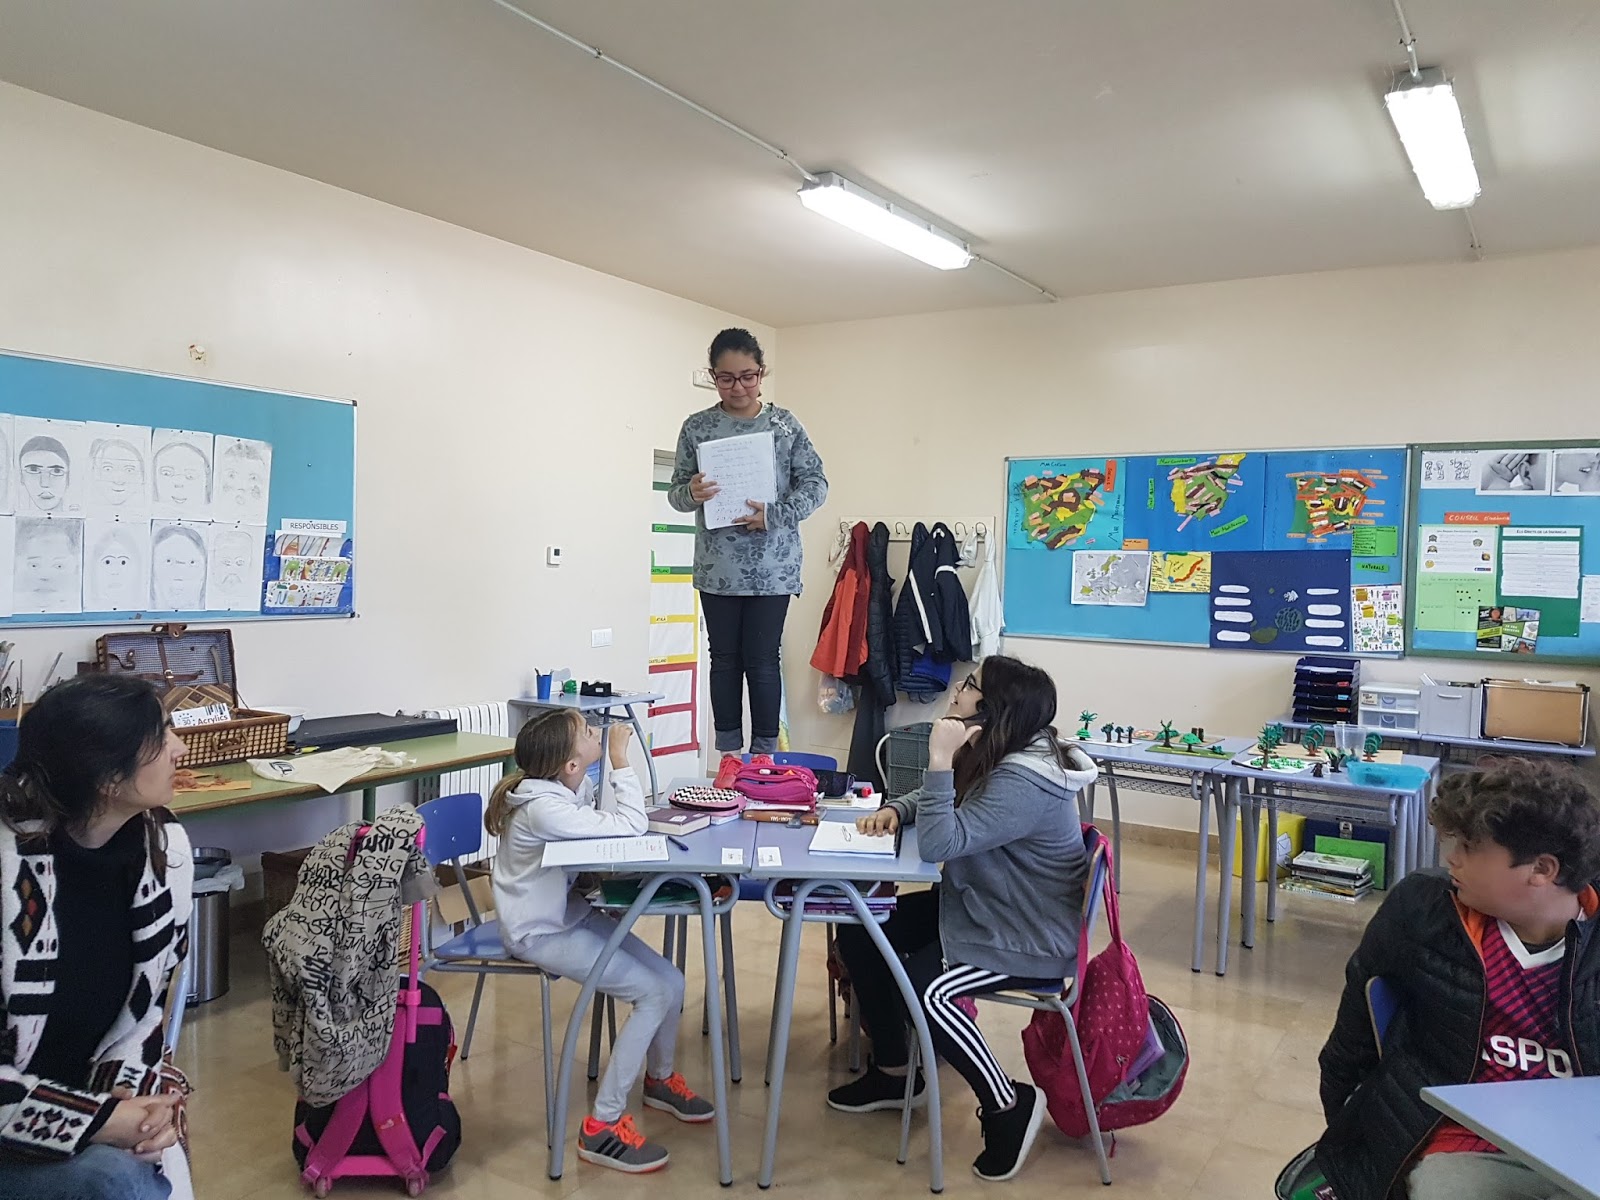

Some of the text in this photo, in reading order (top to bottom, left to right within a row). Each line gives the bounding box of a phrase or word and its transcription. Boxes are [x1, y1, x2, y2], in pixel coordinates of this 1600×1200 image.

[290, 522, 339, 531] RESPONSIBLES
[1361, 563, 1385, 571] NATURALS
[197, 714, 228, 726] Acrylics
